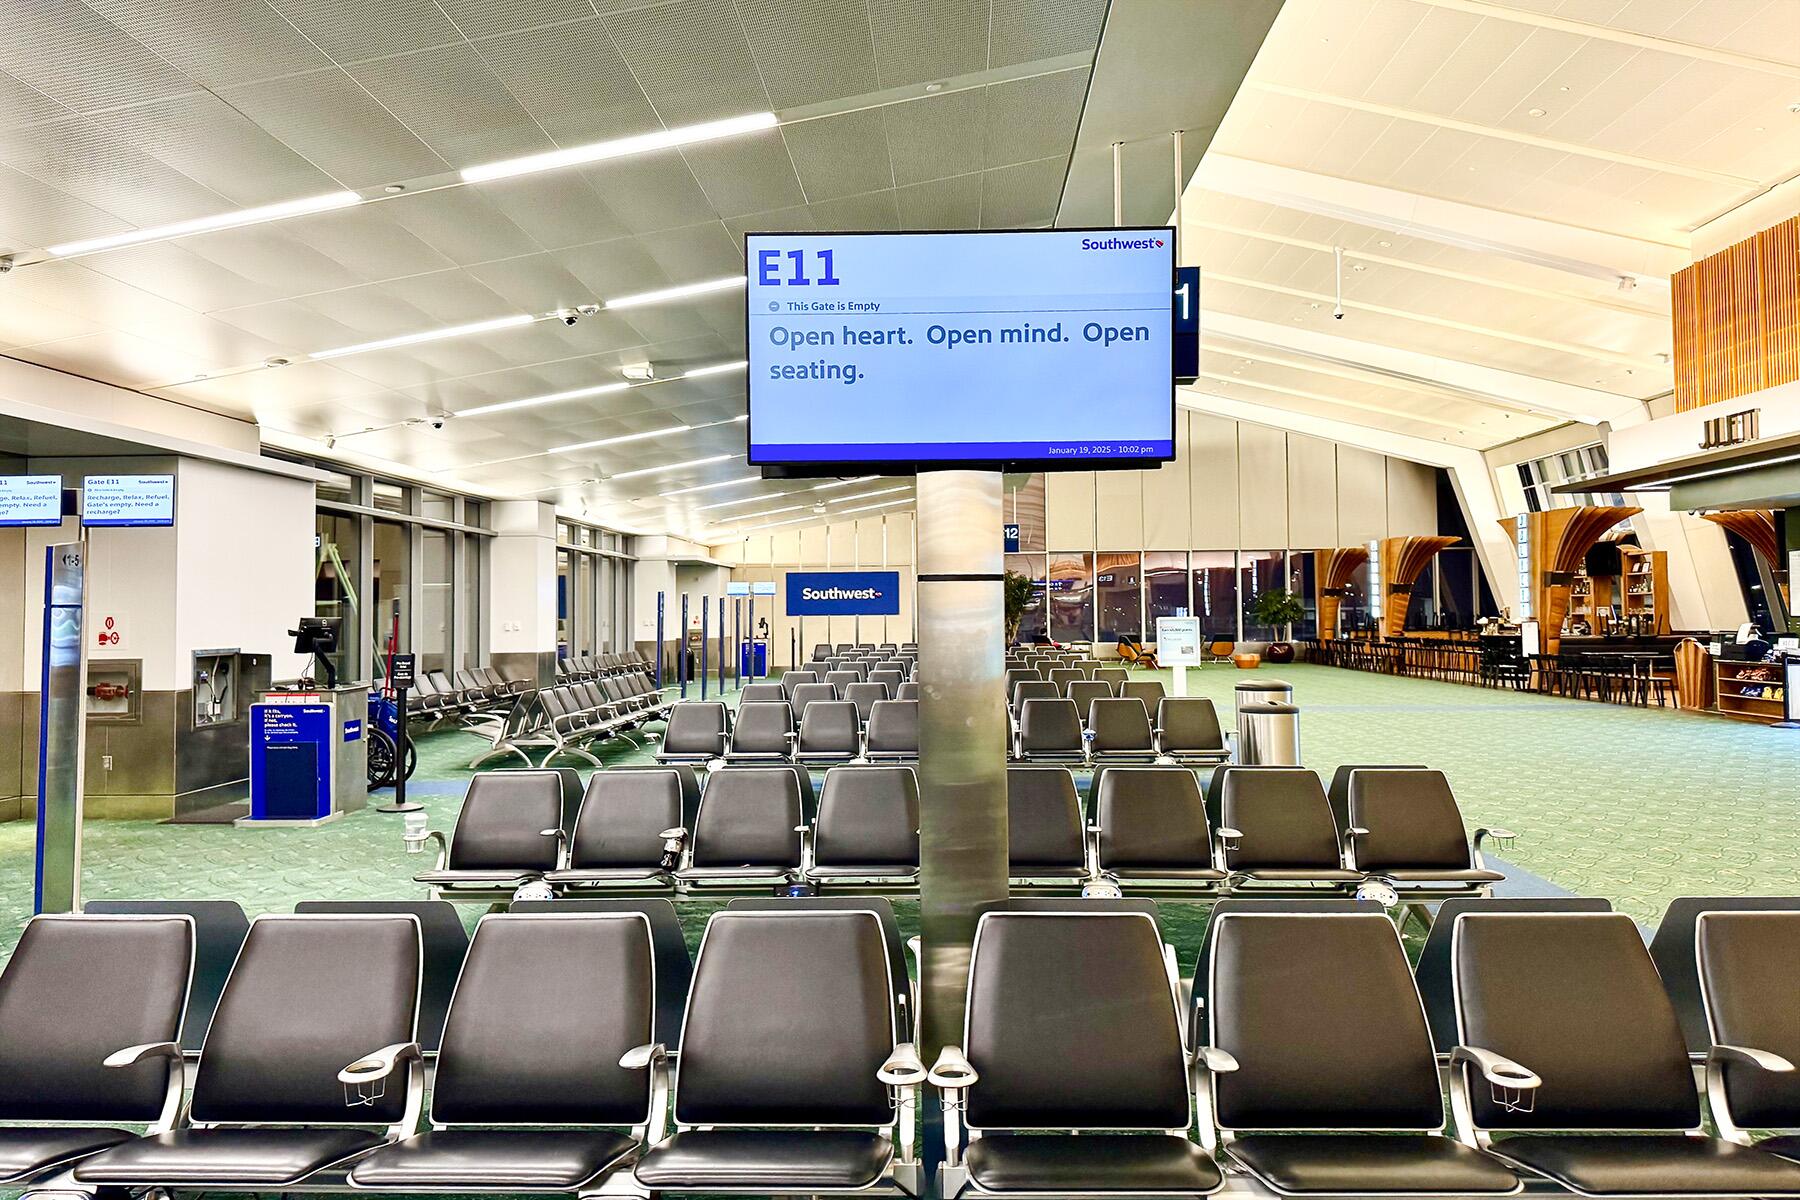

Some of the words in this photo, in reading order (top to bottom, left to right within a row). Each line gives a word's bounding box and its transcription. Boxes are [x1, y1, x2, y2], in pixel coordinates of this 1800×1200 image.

[1082, 237, 1155, 250] Southwest
[758, 249, 840, 286] E11
[787, 301, 809, 311] This
[811, 301, 835, 311] Gate
[837, 301, 845, 311] is
[848, 301, 881, 312] Empty
[769, 326, 835, 351] Open
[843, 325, 913, 345] heart.
[926, 324, 992, 350] Open
[1000, 322, 1069, 343] mind.
[1083, 322, 1150, 347] Open
[770, 359, 864, 385] seating.
[1048, 446, 1078, 455] January
[1079, 446, 1091, 454] 19,
[1092, 446, 1112, 454] 2025
[1119, 445, 1139, 454] 10:02
[1141, 447, 1154, 455] pm
[802, 586, 876, 600] Southwest
